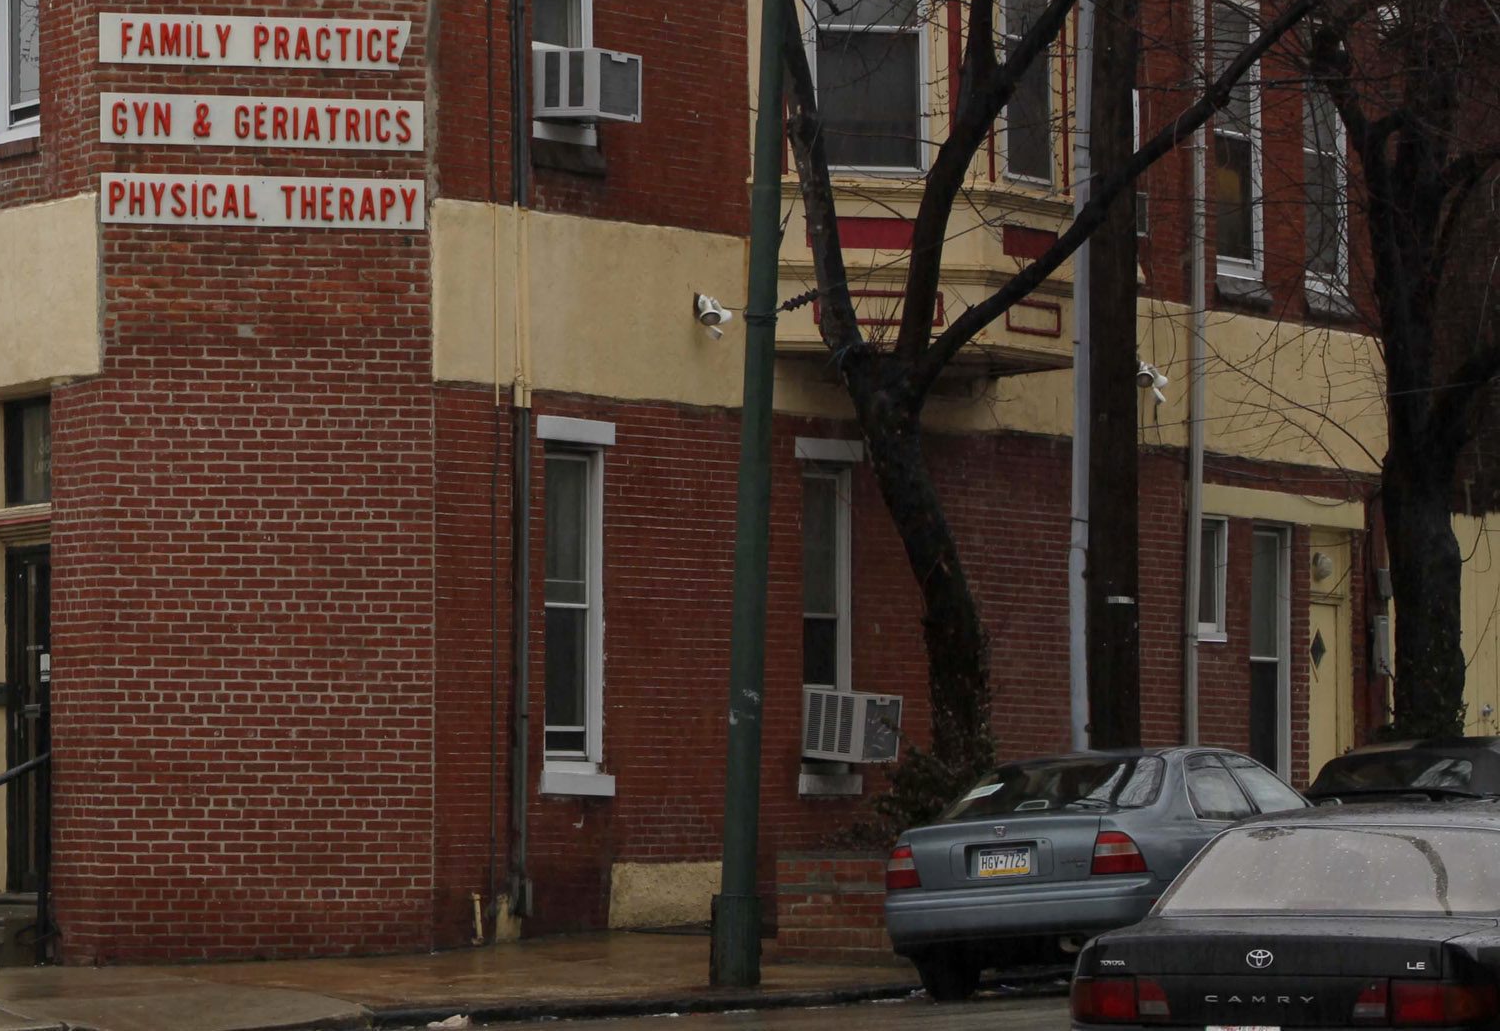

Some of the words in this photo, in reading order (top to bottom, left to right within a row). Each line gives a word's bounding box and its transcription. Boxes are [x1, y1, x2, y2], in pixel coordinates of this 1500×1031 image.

[121, 22, 231, 57] FAMILY
[254, 24, 402, 63] PRACTICE
[112, 101, 171, 136] GYN
[193, 103, 212, 136] &
[235, 104, 411, 142] GERIATRICS
[109, 180, 256, 218] PHYSICAL
[281, 185, 417, 220] THERAPY
[1406, 961, 1426, 970] LE
[1204, 995, 1314, 1004] CAMRY
